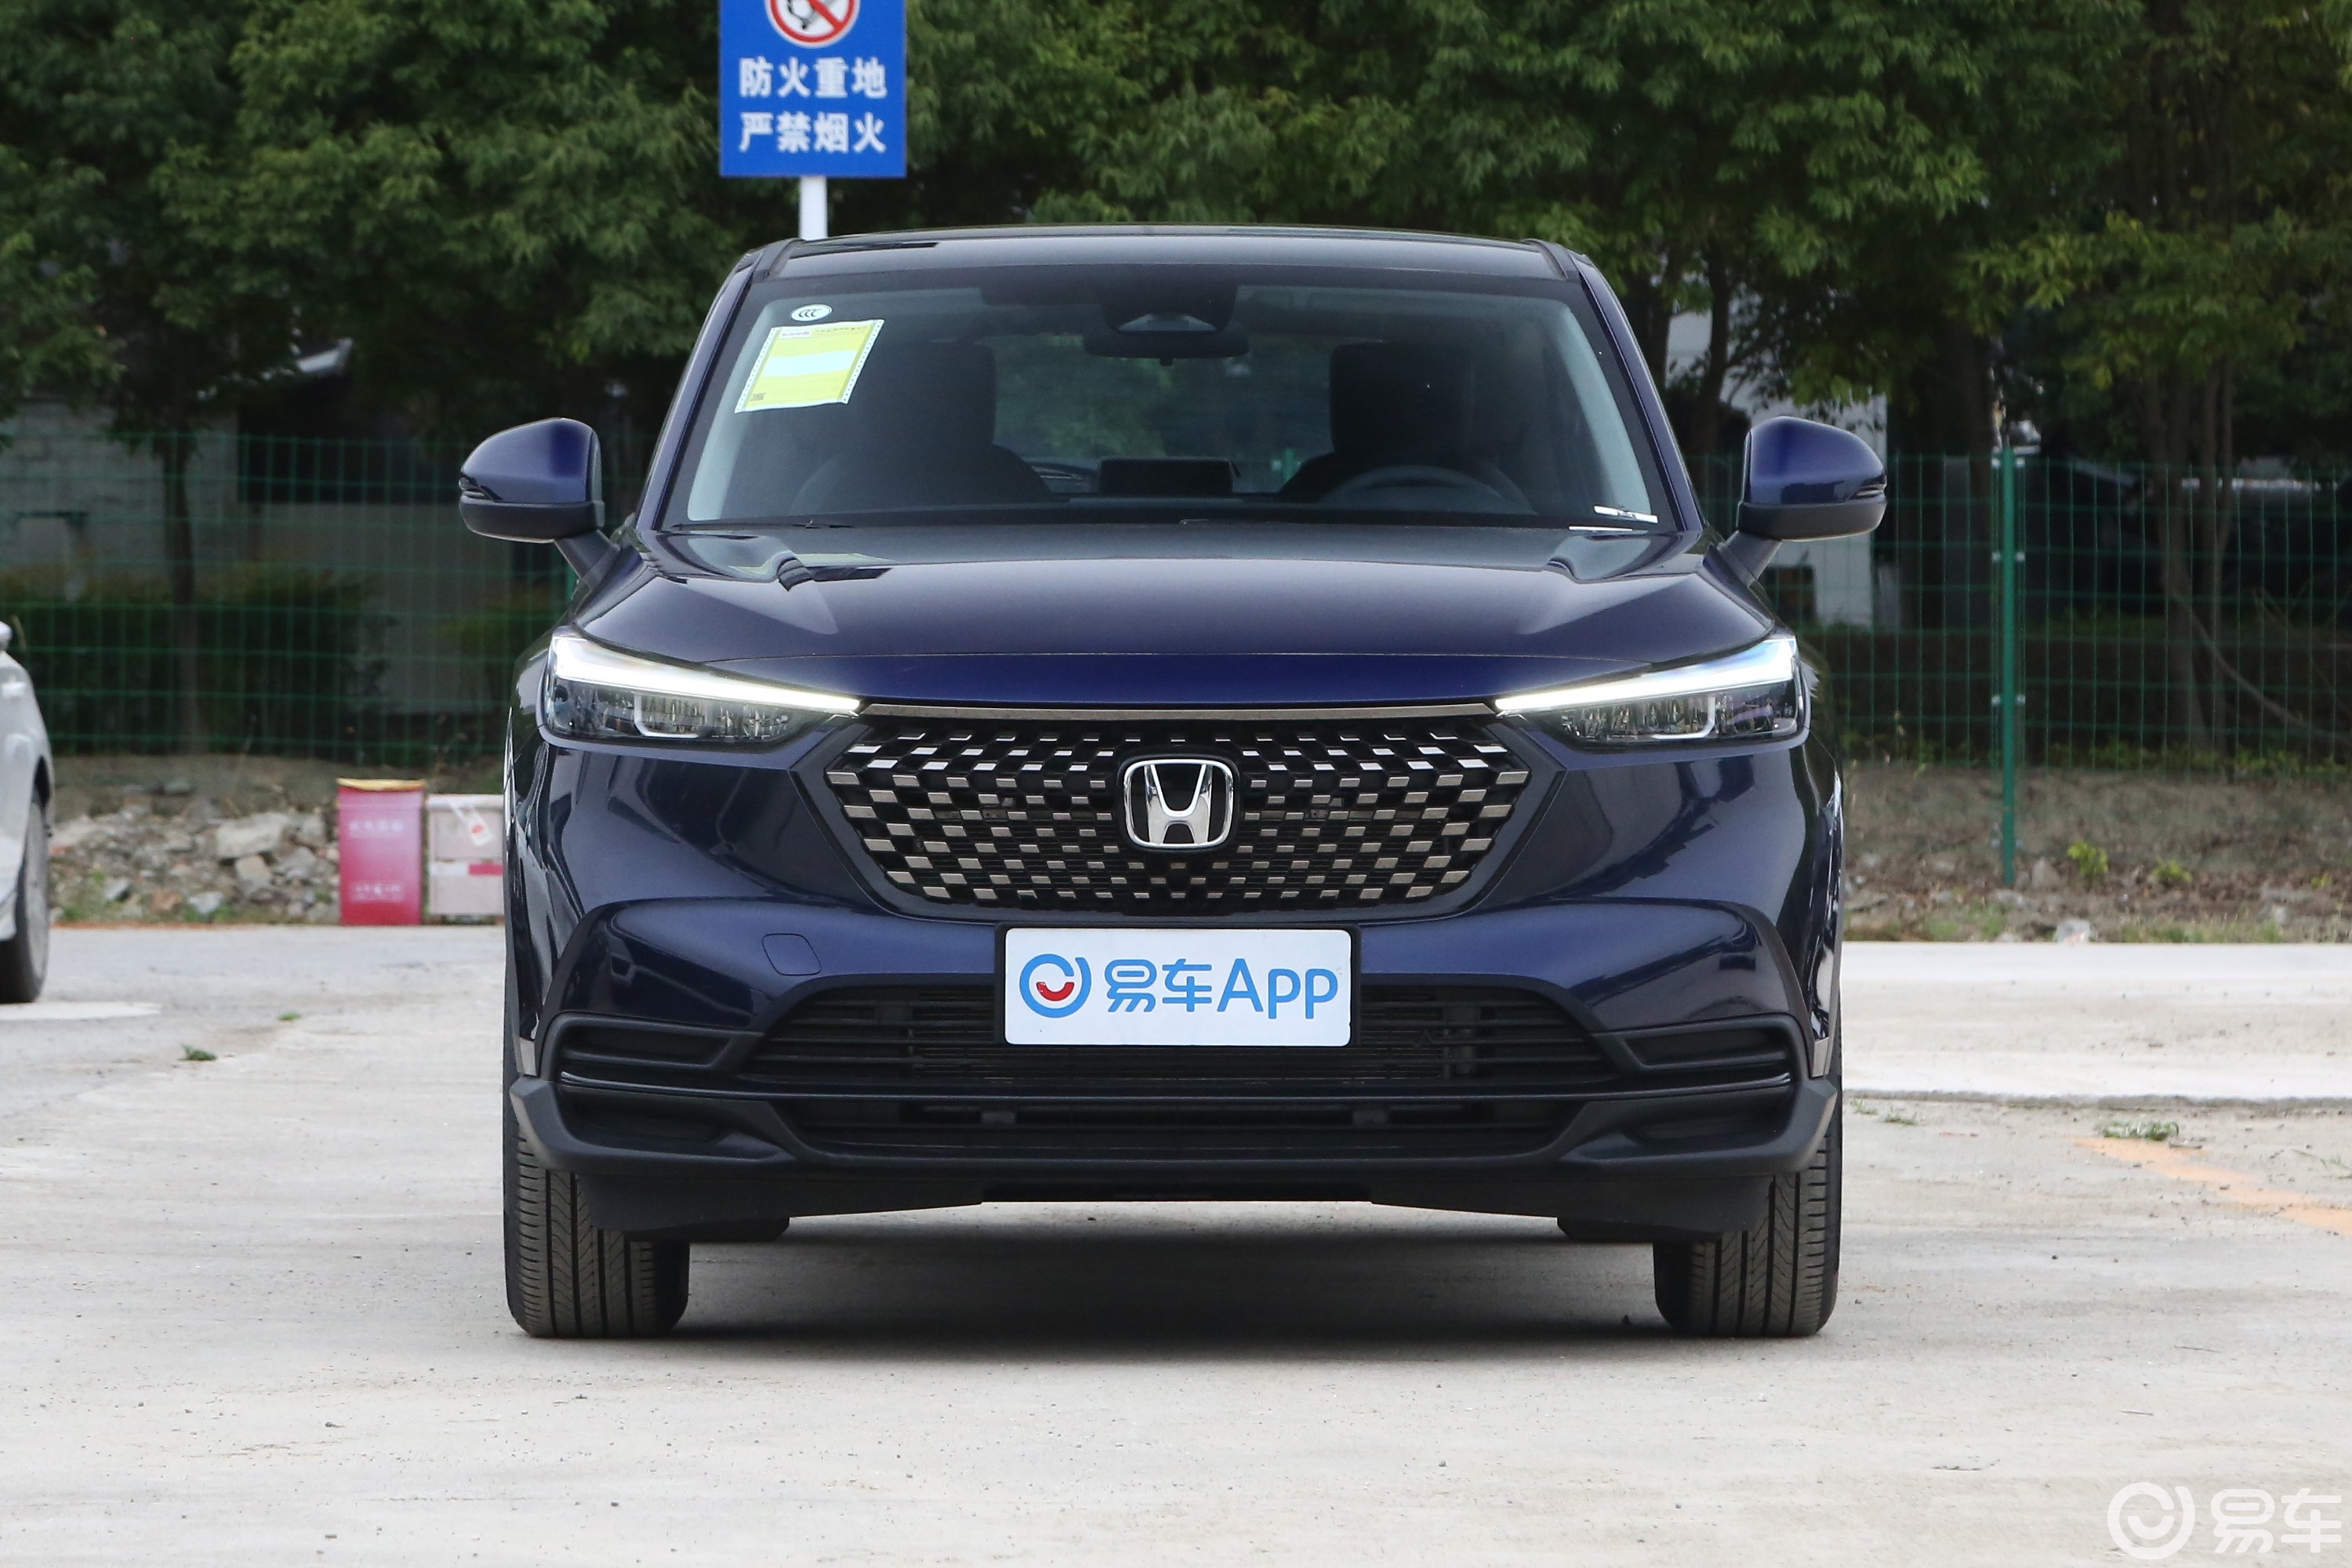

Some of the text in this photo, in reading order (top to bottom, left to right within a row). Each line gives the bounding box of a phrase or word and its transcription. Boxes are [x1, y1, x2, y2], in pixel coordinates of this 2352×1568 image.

[739, 56, 887, 99] 防火重地
[739, 111, 887, 154] 严禁烟火
[1104, 957, 1339, 1019] 易车App
